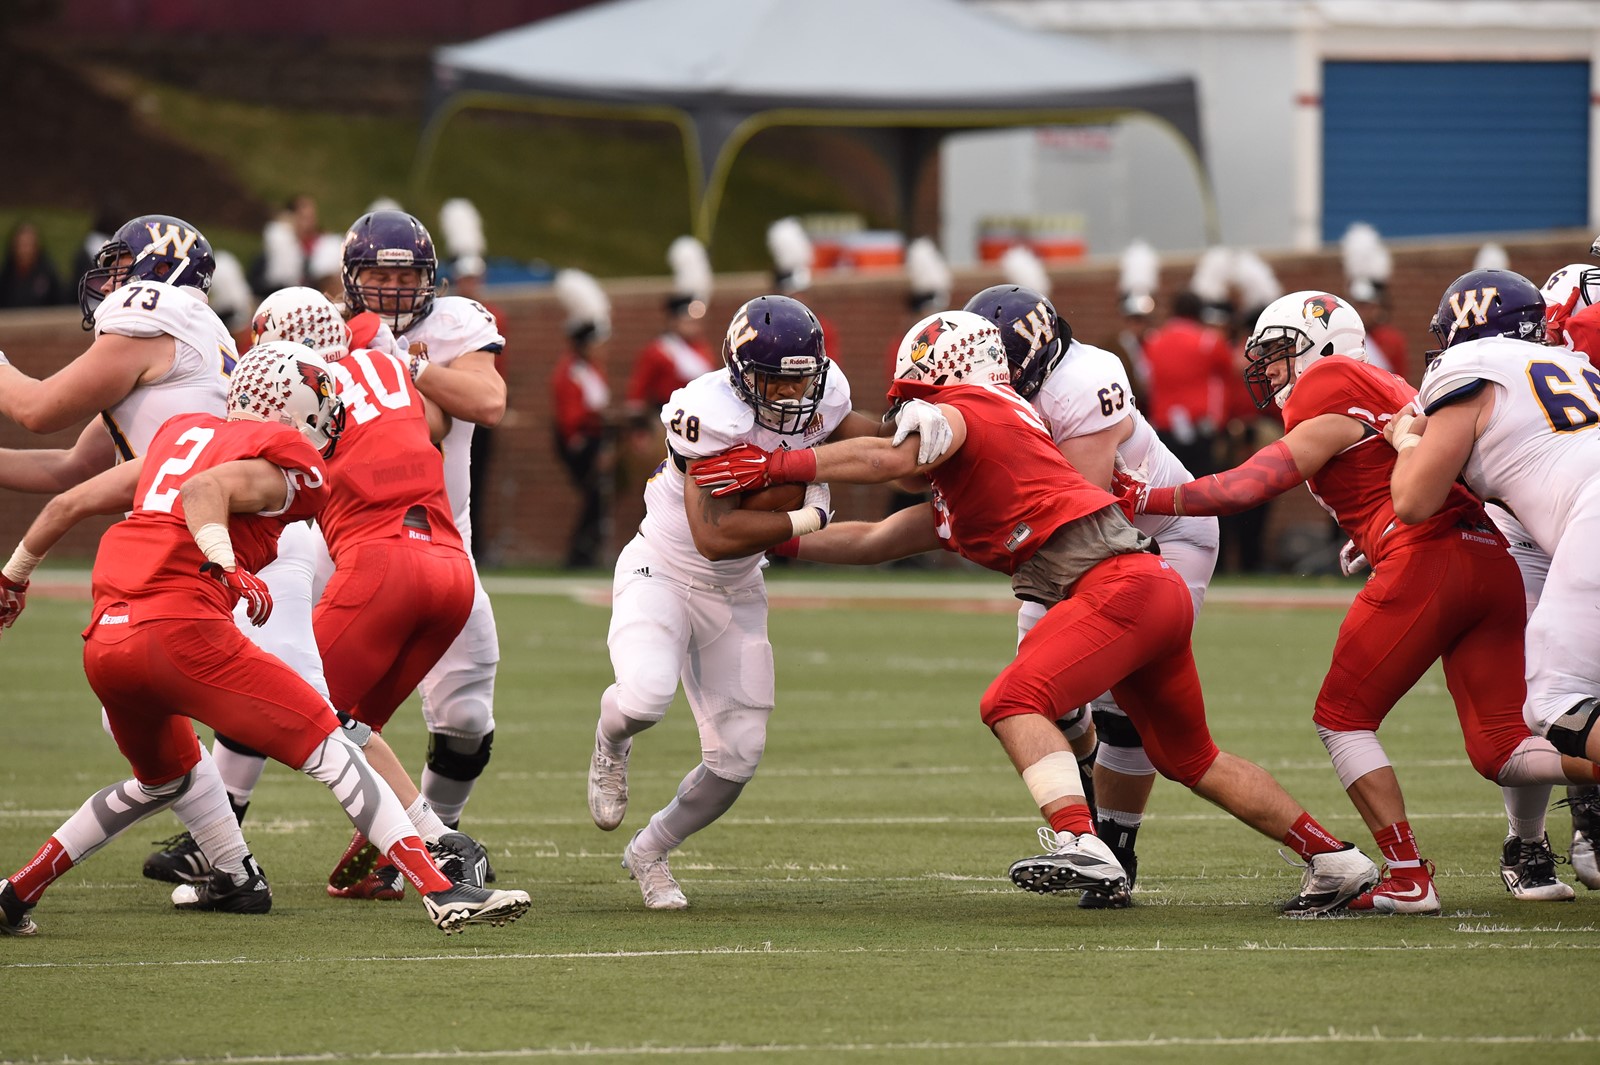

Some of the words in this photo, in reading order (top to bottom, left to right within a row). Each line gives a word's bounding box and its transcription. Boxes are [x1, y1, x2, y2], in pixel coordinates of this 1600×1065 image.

[147, 222, 198, 260] W
[121, 286, 161, 313] 73
[1449, 287, 1497, 329] W
[1013, 301, 1055, 351] W
[322, 350, 341, 361] dell
[1097, 382, 1125, 417] 63
[670, 409, 700, 443] 28
[142, 426, 215, 513] 2
[1461, 532, 1498, 545] REDBIRDS
[12, 843, 53, 883] REDBIRDS
